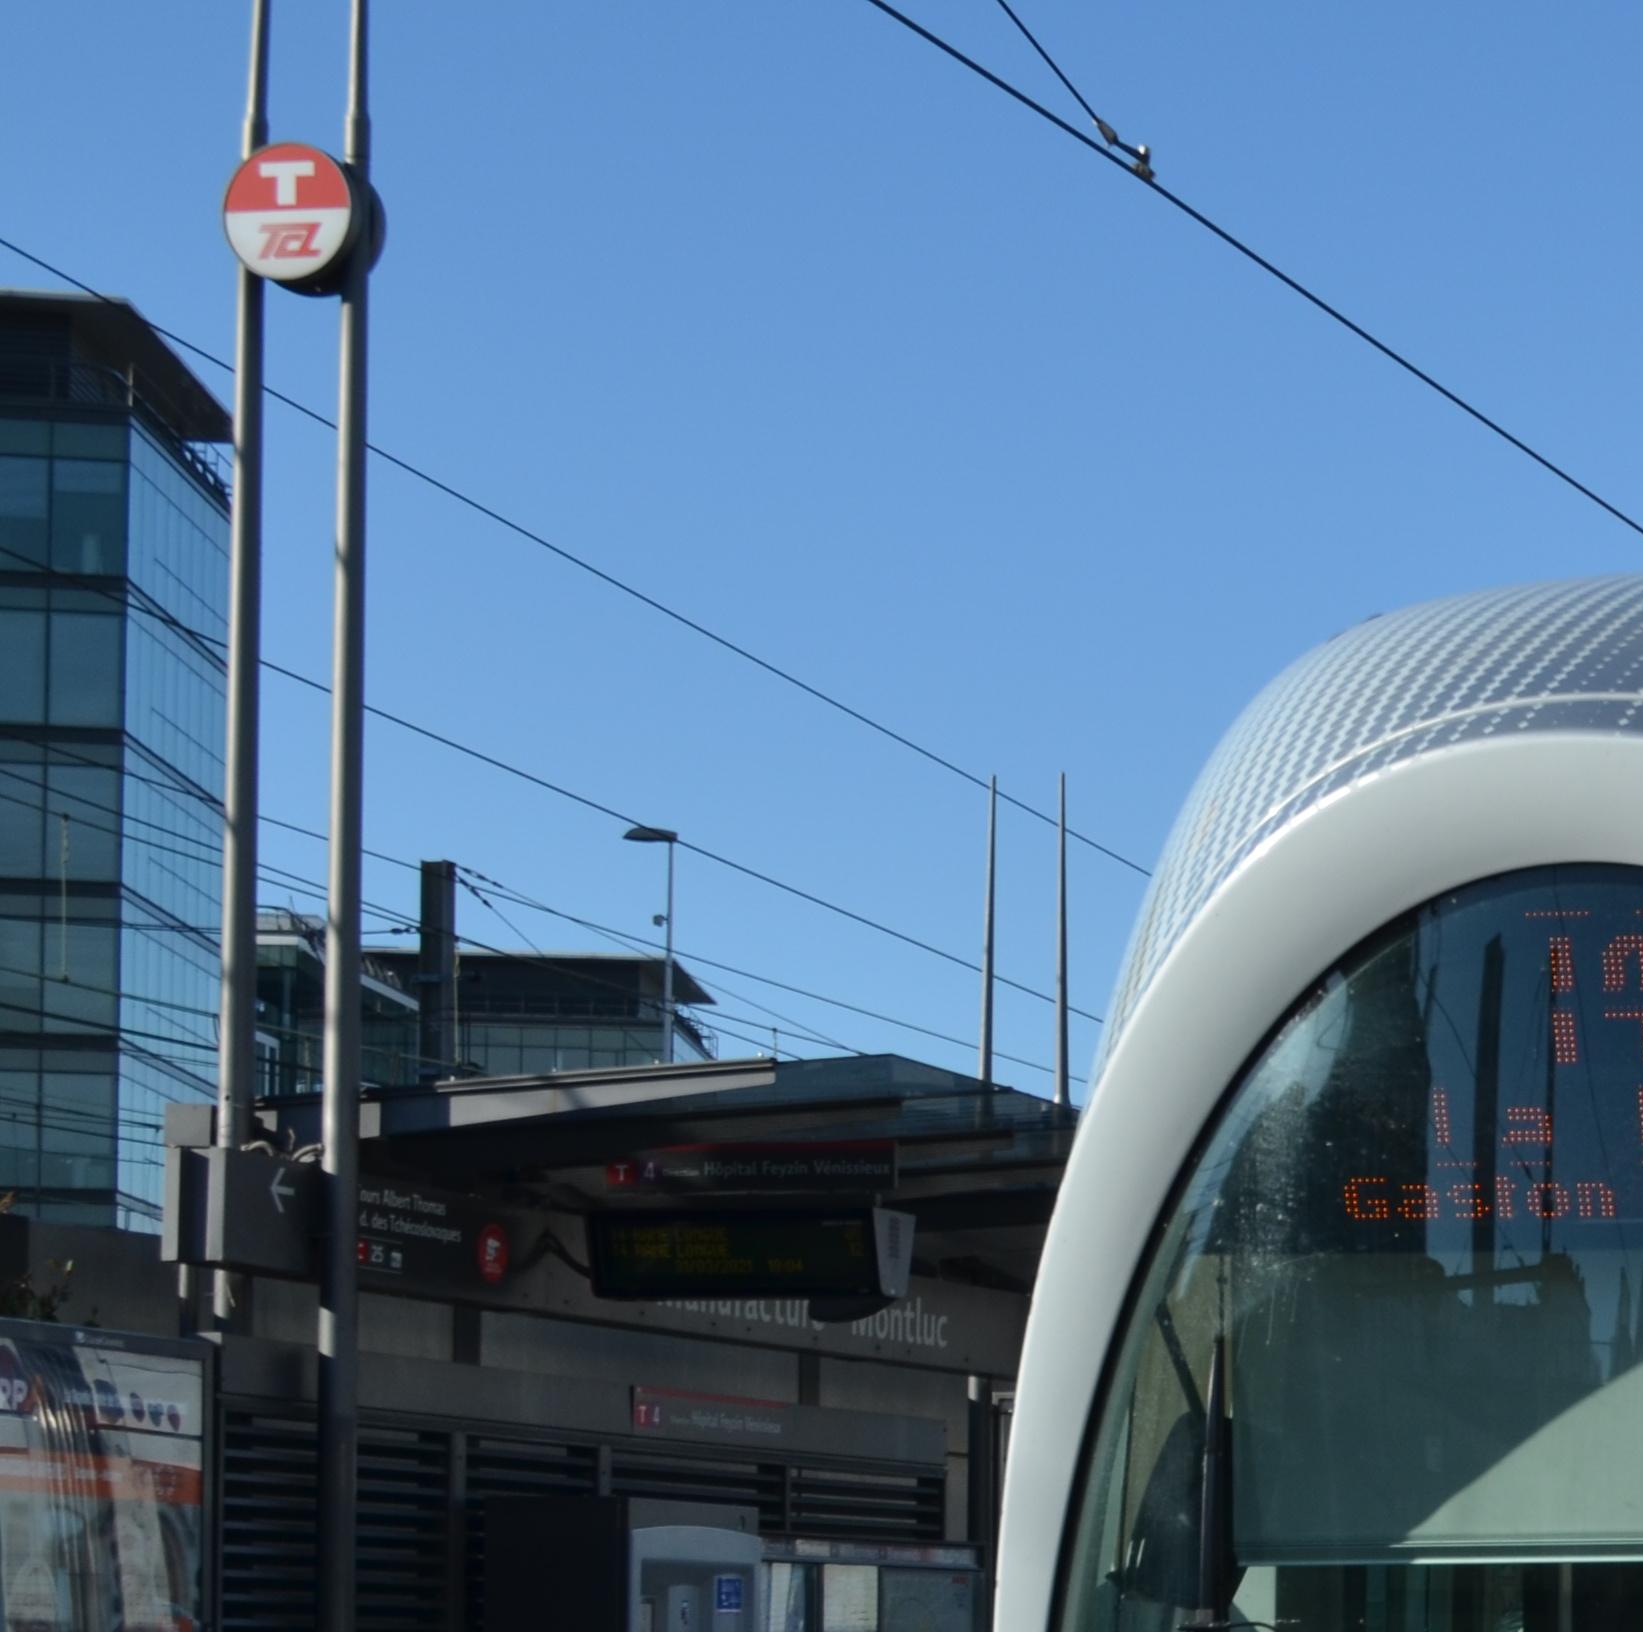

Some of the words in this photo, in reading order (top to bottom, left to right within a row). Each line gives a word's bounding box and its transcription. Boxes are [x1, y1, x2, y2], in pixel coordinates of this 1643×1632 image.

[258, 160, 316, 206] T
[258, 222, 323, 260] TCL
[643, 1161, 656, 1180] 4
[704, 1159, 757, 1178] Hôpital
[762, 1159, 807, 1178] Feyzin
[814, 1158, 891, 1176] Vénissieux
[1343, 1174, 1617, 1220] Gaston
